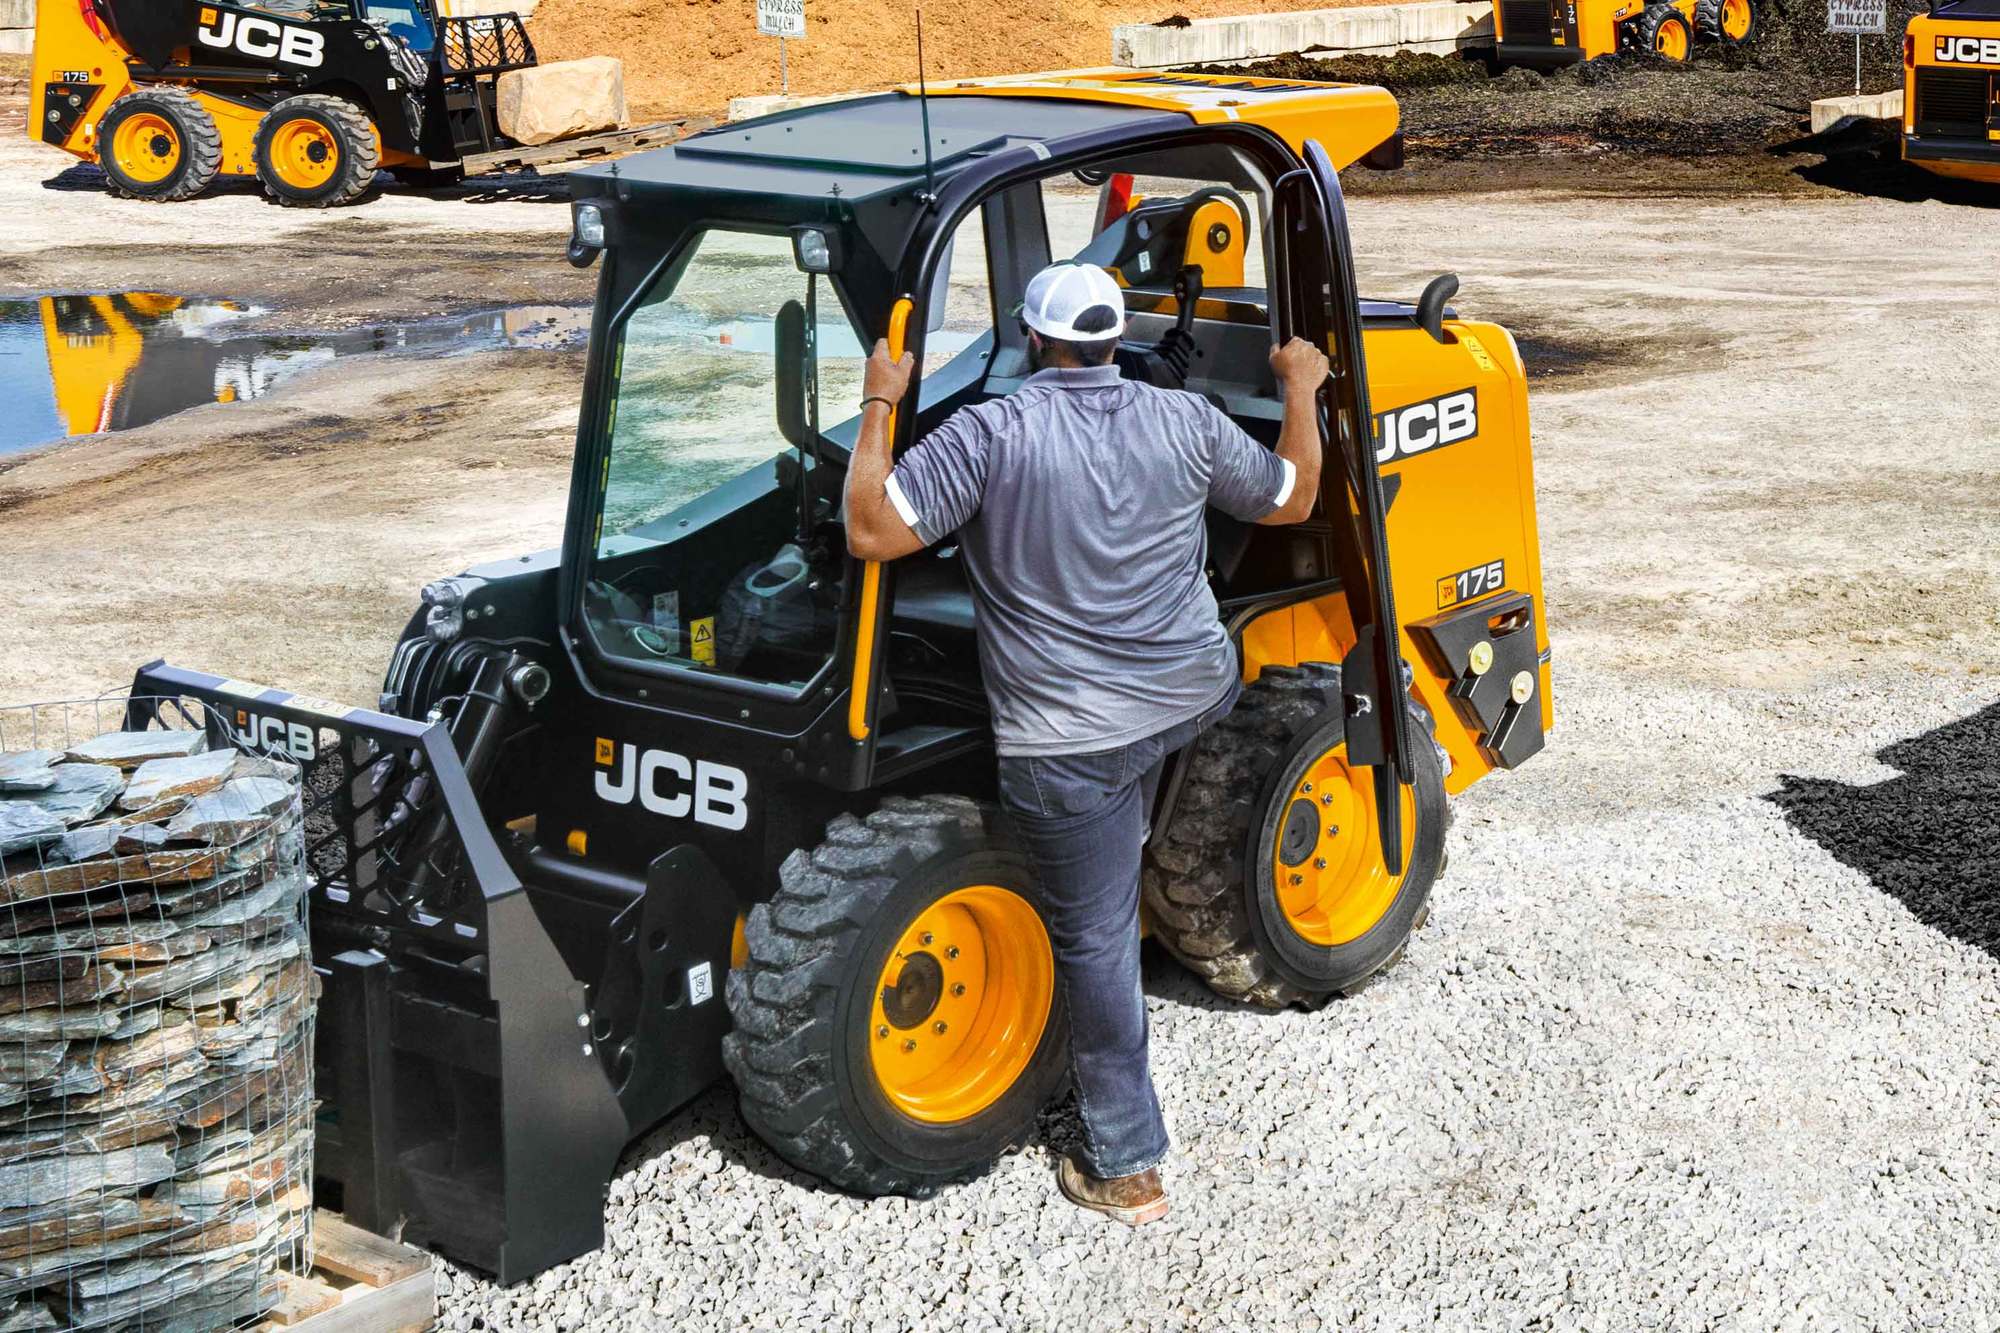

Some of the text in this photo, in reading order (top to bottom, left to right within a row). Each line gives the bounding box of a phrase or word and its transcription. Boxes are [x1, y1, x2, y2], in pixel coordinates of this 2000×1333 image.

[1567, 5, 1576, 24] 175
[198, 12, 325, 67] JCB
[1936, 37, 2000, 63] JCB
[64, 71, 88, 82] 175
[1376, 392, 1477, 463] JCB
[1457, 561, 1503, 599] 175
[238, 713, 315, 760] JCB
[594, 743, 748, 831] JCB
